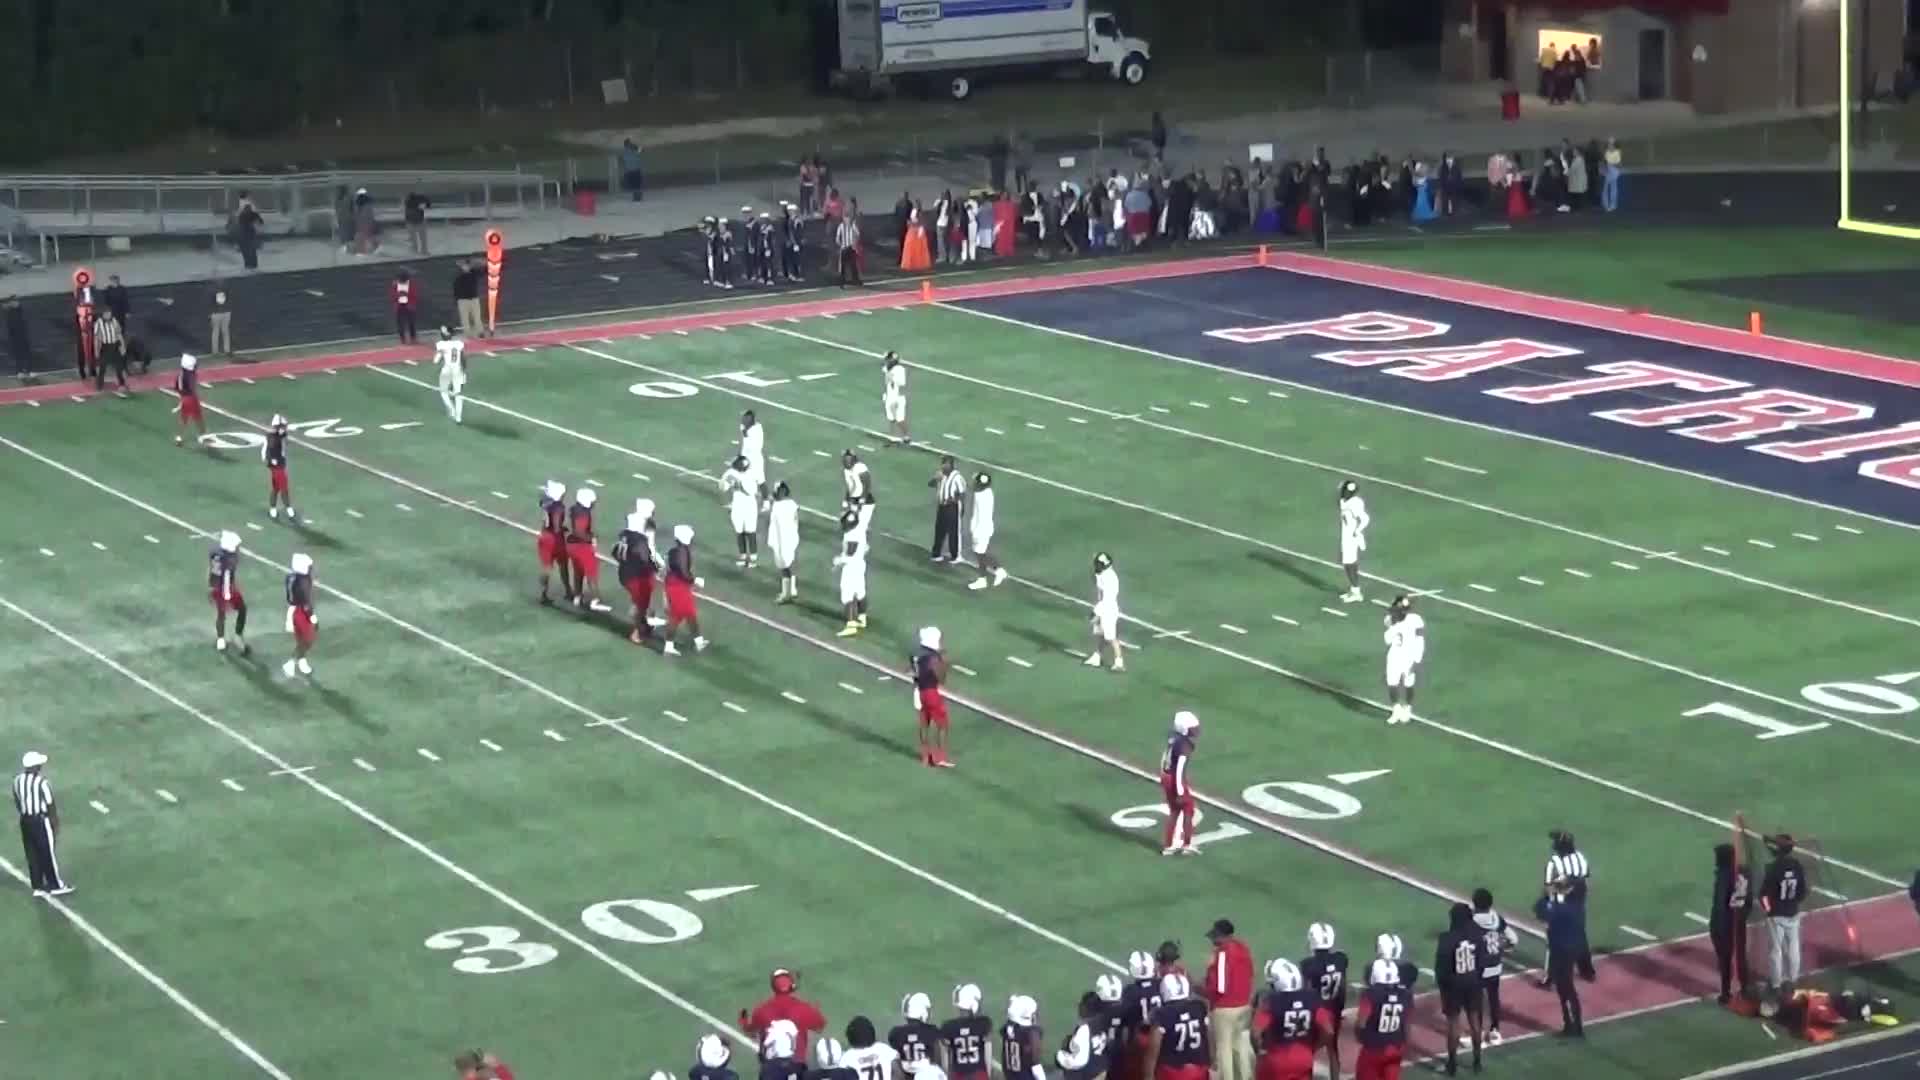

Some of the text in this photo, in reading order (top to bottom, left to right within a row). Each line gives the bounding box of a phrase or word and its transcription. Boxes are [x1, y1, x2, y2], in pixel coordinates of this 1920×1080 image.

[628, 371, 792, 398] 10
[1203, 311, 1920, 490] PATRI
[198, 418, 364, 449] 20
[1681, 682, 1920, 740] 10
[424, 899, 703, 974] 30
[1320, 971, 1343, 1001] 27
[1283, 1009, 1312, 1038] 53
[1378, 1003, 1404, 1034] 66
[953, 1035, 980, 1065] 25
[1174, 1019, 1202, 1052] 75
